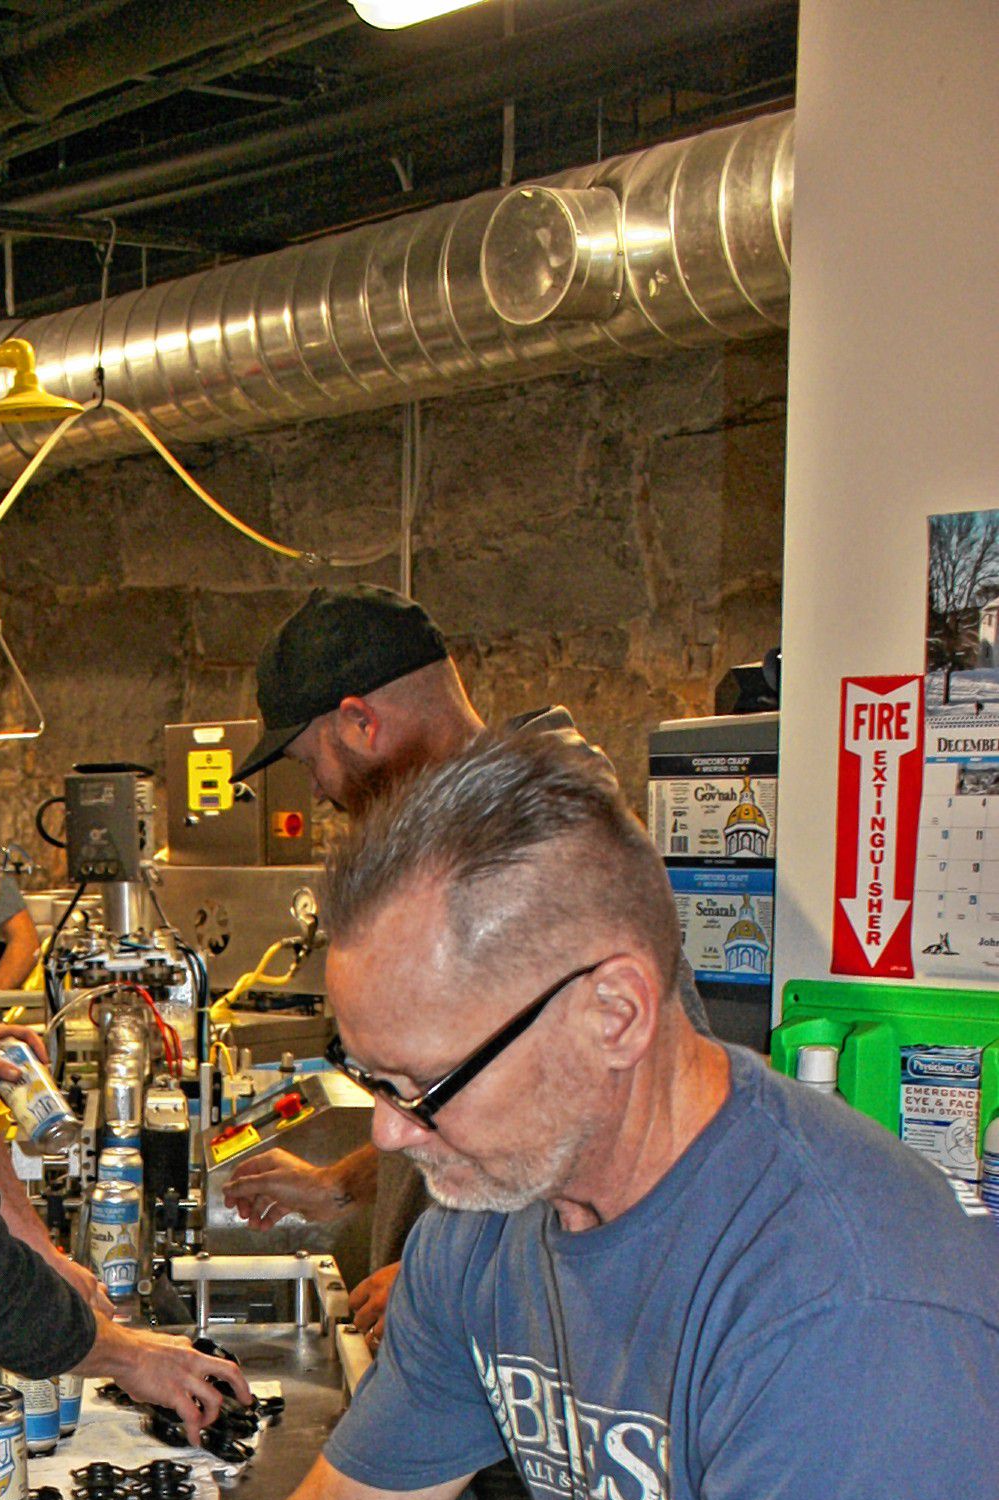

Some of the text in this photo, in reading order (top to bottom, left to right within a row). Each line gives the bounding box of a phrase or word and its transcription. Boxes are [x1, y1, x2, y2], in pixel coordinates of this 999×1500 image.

[853, 701, 911, 741] FIRE
[937, 737, 999, 752] DECEMBE
[865, 750, 888, 946] EXTINGUISHER
[905, 1087, 979, 1099] EMERGENC
[905, 1096, 930, 1106] EYE
[934, 1098, 943, 1107] &
[905, 1106, 979, 1118] WASH STATIO
[523, 1457, 557, 1485] ALT
